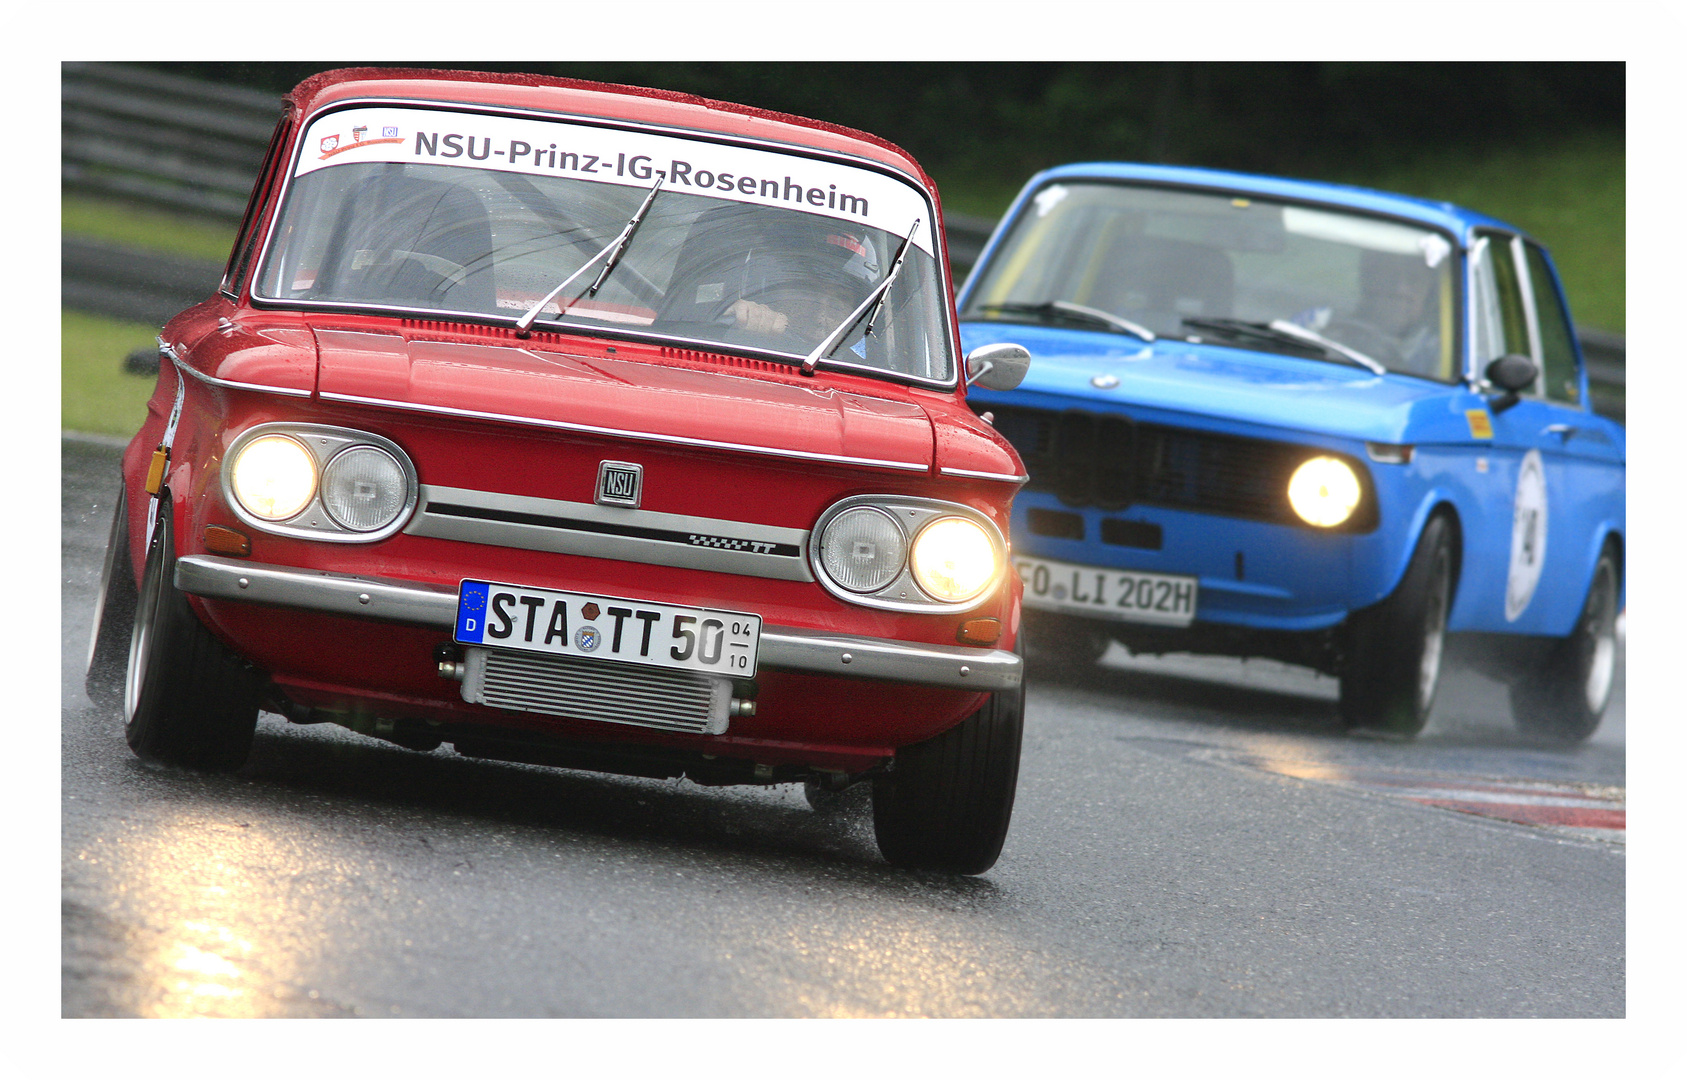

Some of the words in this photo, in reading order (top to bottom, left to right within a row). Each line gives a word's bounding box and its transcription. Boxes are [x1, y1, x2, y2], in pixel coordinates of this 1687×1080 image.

[606, 471, 633, 496] NSU
[751, 541, 776, 554] TT
[1071, 570, 1107, 606] LI
[1116, 576, 1193, 615] 202H
[465, 618, 477, 632] D
[487, 592, 568, 647] STA
[606, 606, 661, 657] TT
[669, 614, 725, 666] 50
[731, 621, 751, 637] 04
[729, 654, 748, 669] 10
